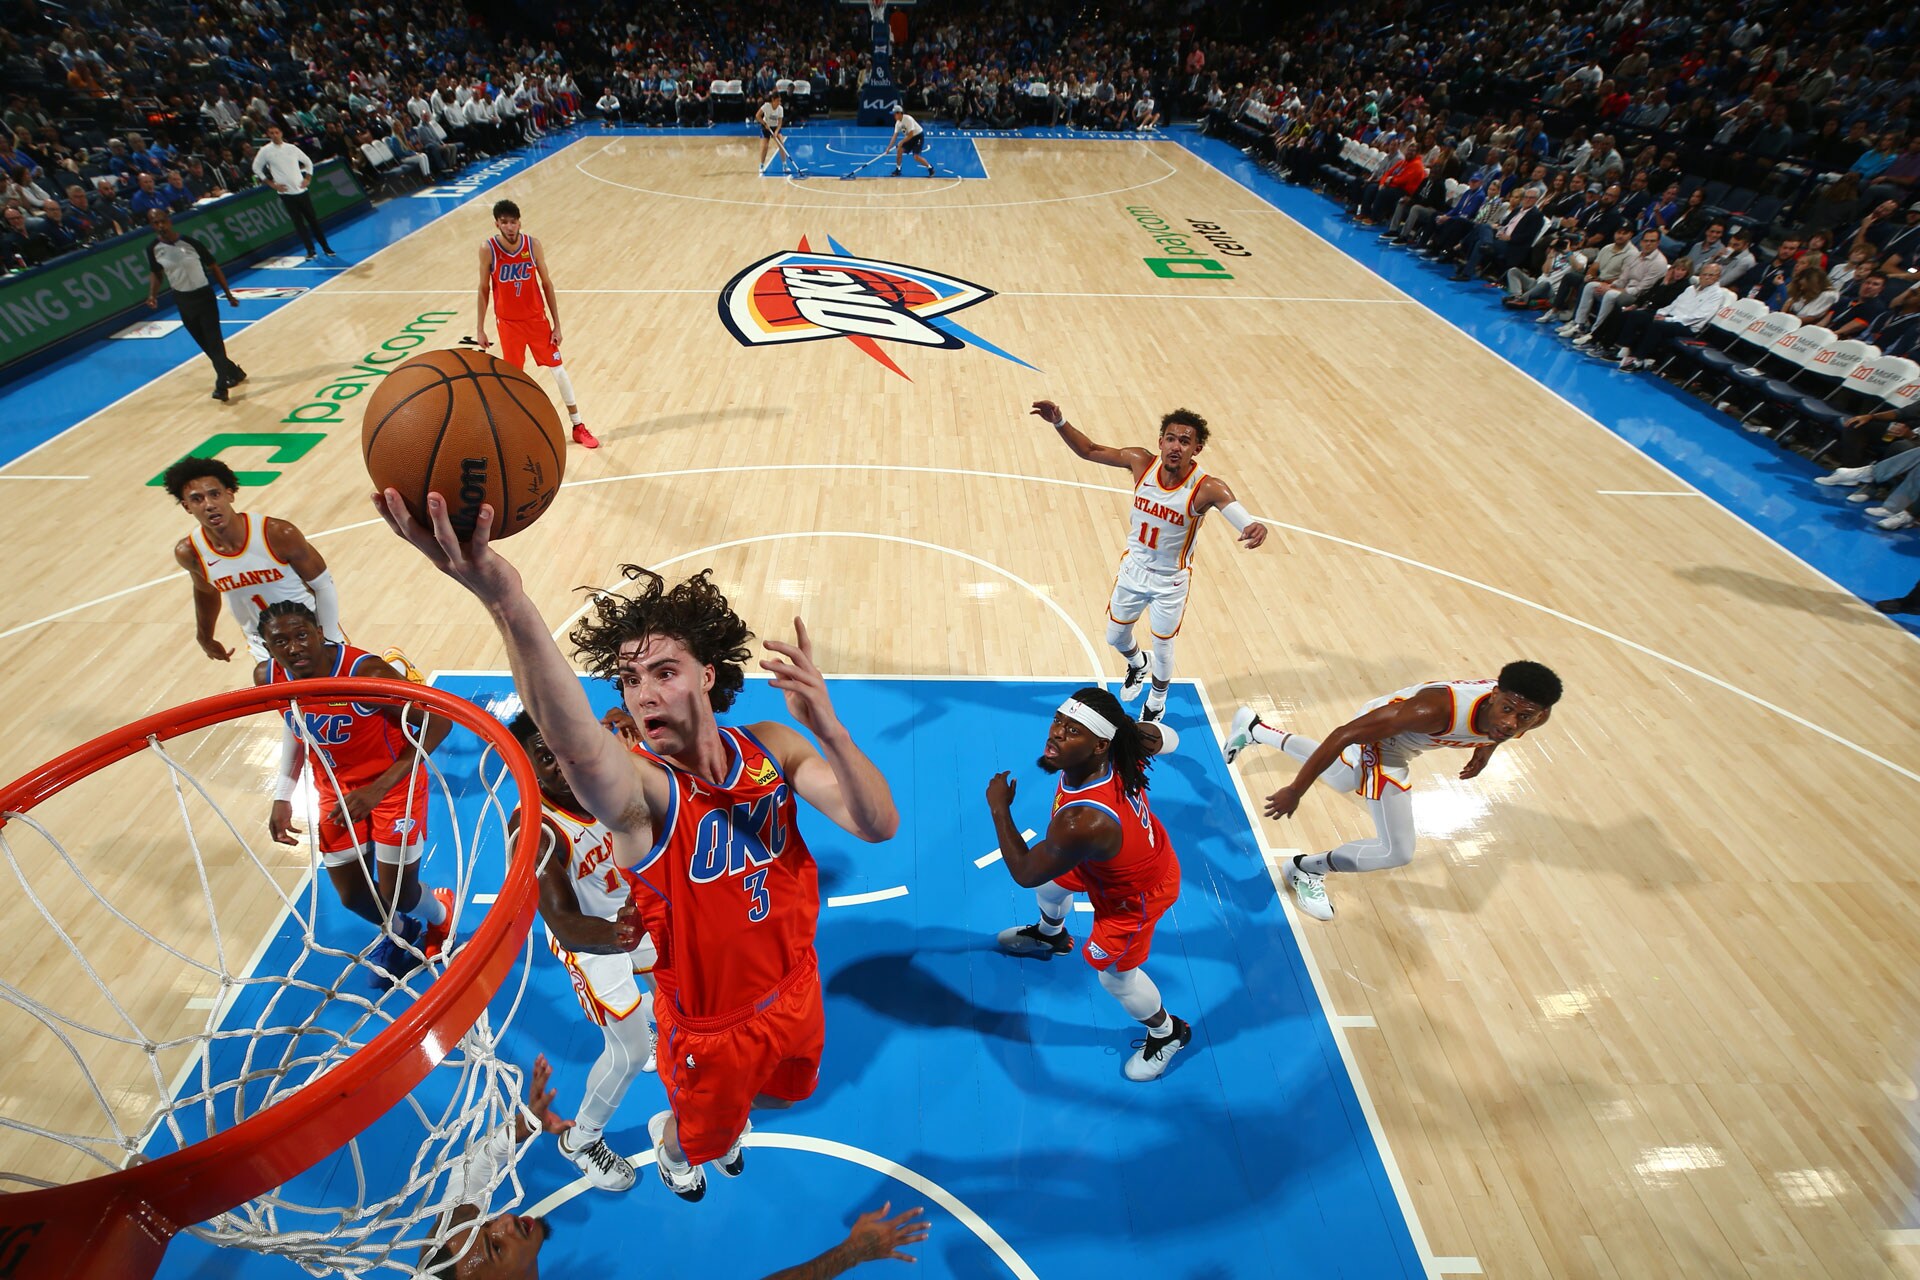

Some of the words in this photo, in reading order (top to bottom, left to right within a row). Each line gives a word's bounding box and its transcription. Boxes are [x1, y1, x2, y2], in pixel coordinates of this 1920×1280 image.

[870, 78, 891, 87] Health
[454, 157, 525, 186] paycom
[1126, 206, 1209, 256] paycom
[1184, 218, 1253, 257] center
[499, 262, 533, 282] OKC
[62, 272, 111, 309] 50
[514, 281, 522, 297] 7
[781, 266, 947, 345] OKC
[280, 311, 459, 423] paycom
[1866, 376, 1887, 386] BANK
[1134, 496, 1184, 527] ATLANTA
[1138, 521, 1159, 550] 11
[213, 567, 285, 593] ATLANTA
[283, 709, 354, 745] OKC
[689, 783, 789, 884] OKC
[743, 867, 771, 922] 3
